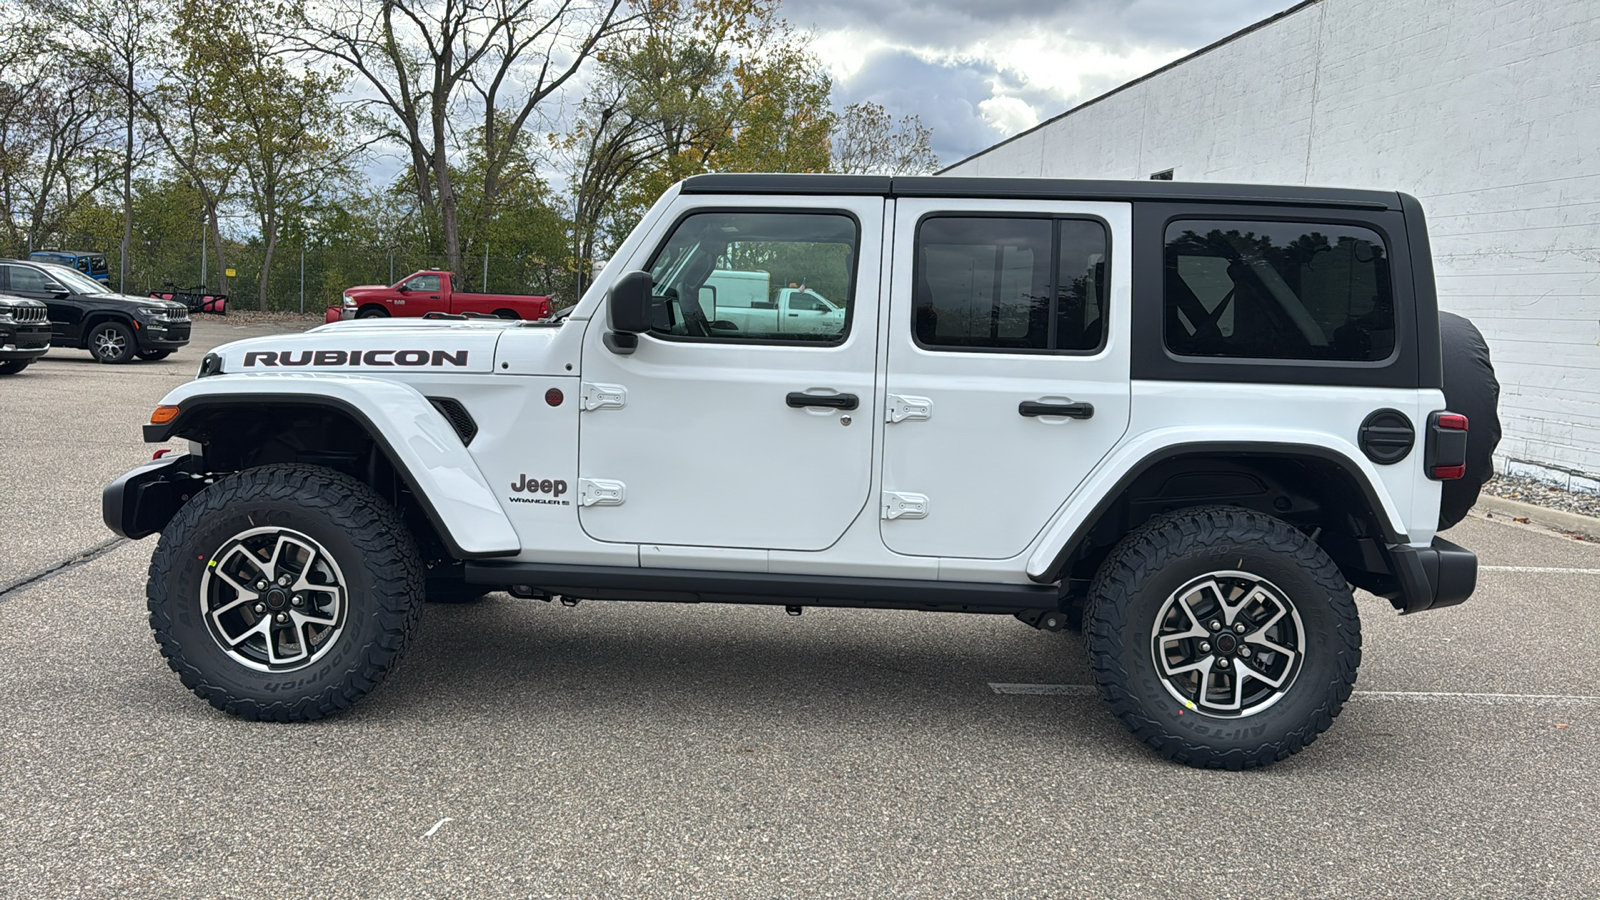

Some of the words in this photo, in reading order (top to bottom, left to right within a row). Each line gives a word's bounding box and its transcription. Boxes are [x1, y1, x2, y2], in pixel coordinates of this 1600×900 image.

[243, 350, 469, 367] RUBICON
[510, 473, 567, 497] Jeep
[508, 496, 560, 505] WRANGLER
